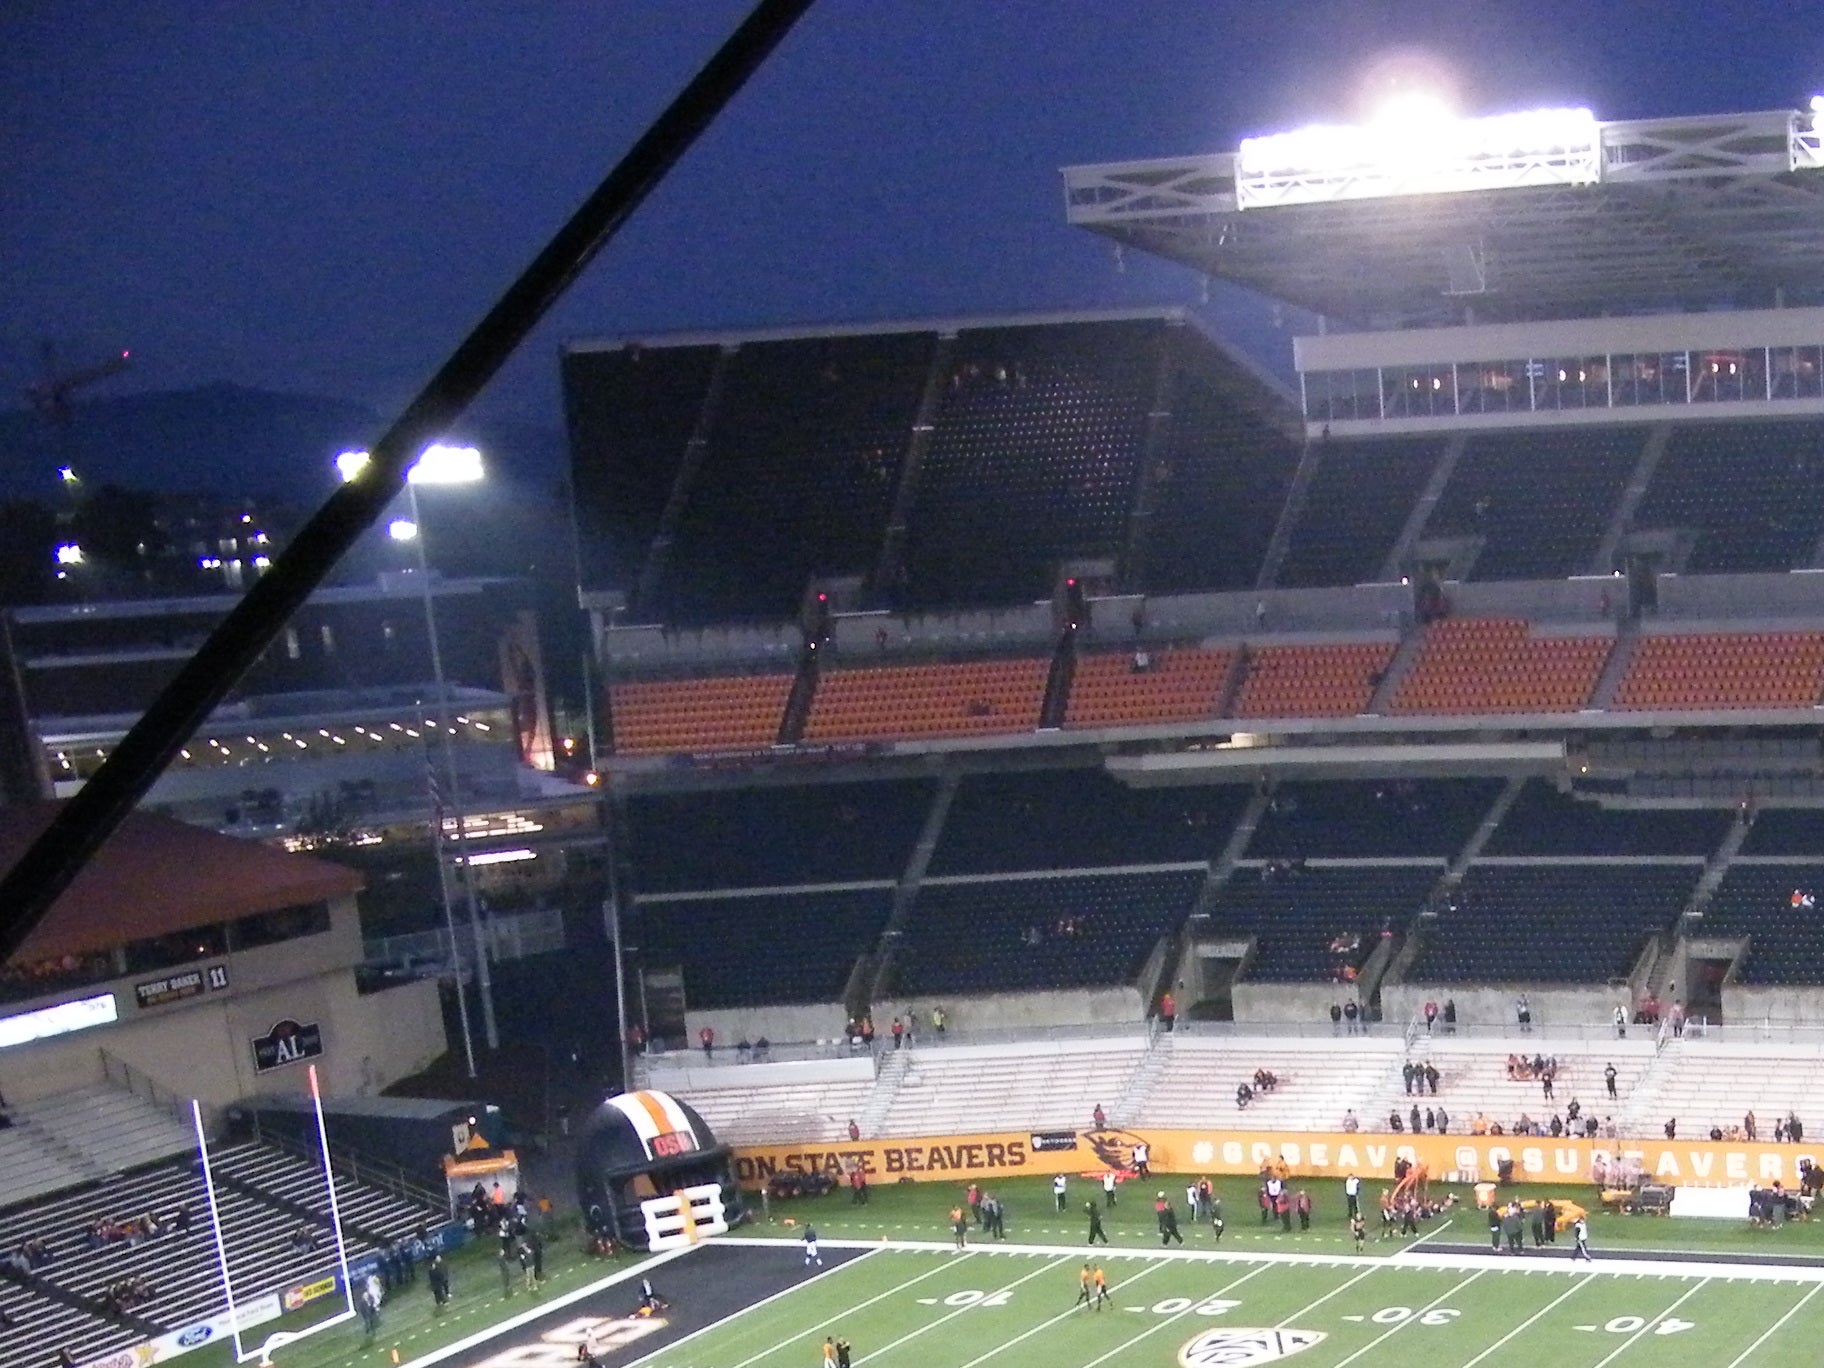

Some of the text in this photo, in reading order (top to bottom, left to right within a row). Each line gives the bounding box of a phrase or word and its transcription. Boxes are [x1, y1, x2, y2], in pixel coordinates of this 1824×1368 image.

[276, 1035, 305, 1063] AL
[884, 1141, 1026, 1173] BEAVERS
[1151, 1297, 1242, 1316] 20
[1371, 1307, 1461, 1325] 30
[1604, 1316, 1695, 1335] 40
